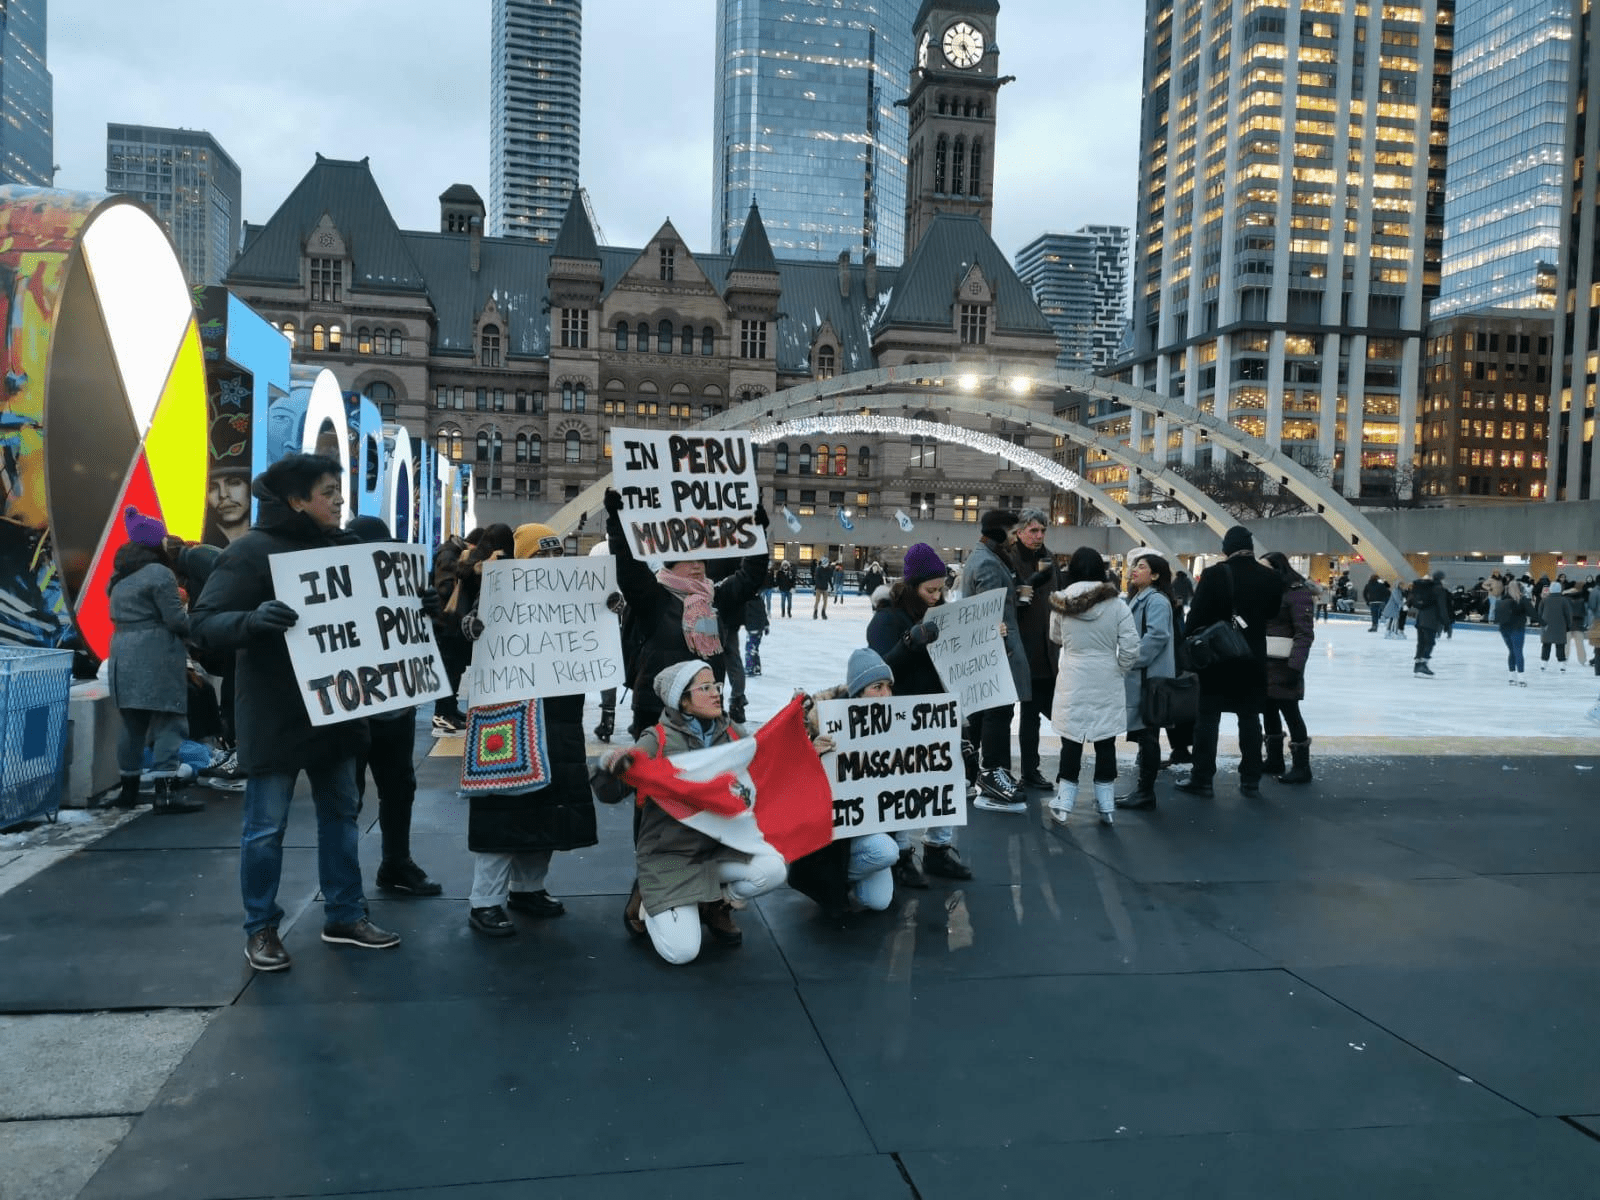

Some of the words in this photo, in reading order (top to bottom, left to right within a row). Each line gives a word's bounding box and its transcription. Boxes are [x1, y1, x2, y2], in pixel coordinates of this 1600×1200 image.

[624, 441, 658, 470] IN
[669, 434, 746, 475] PERU
[622, 486, 661, 509] THE
[671, 480, 752, 512] POLICE
[631, 516, 757, 556] MURDERS
[299, 565, 352, 605] IN
[372, 550, 426, 598] PERU
[308, 621, 361, 653] THE
[376, 606, 430, 650] POLICE
[487, 602, 601, 626] GOVERNMENT
[487, 630, 599, 660] VIOLATES
[970, 625, 998, 648] KILLS
[308, 655, 440, 715] TORTURES
[474, 662, 535, 695] HUMAN
[552, 658, 616, 684] RIGHTS
[826, 720, 842, 734] IN
[848, 703, 892, 739] PERU
[895, 711, 906, 720] THE
[911, 701, 957, 731] STATE
[837, 742, 953, 782] MASSACRES
[832, 797, 864, 827] ITS
[878, 784, 957, 823] PEOPLE
